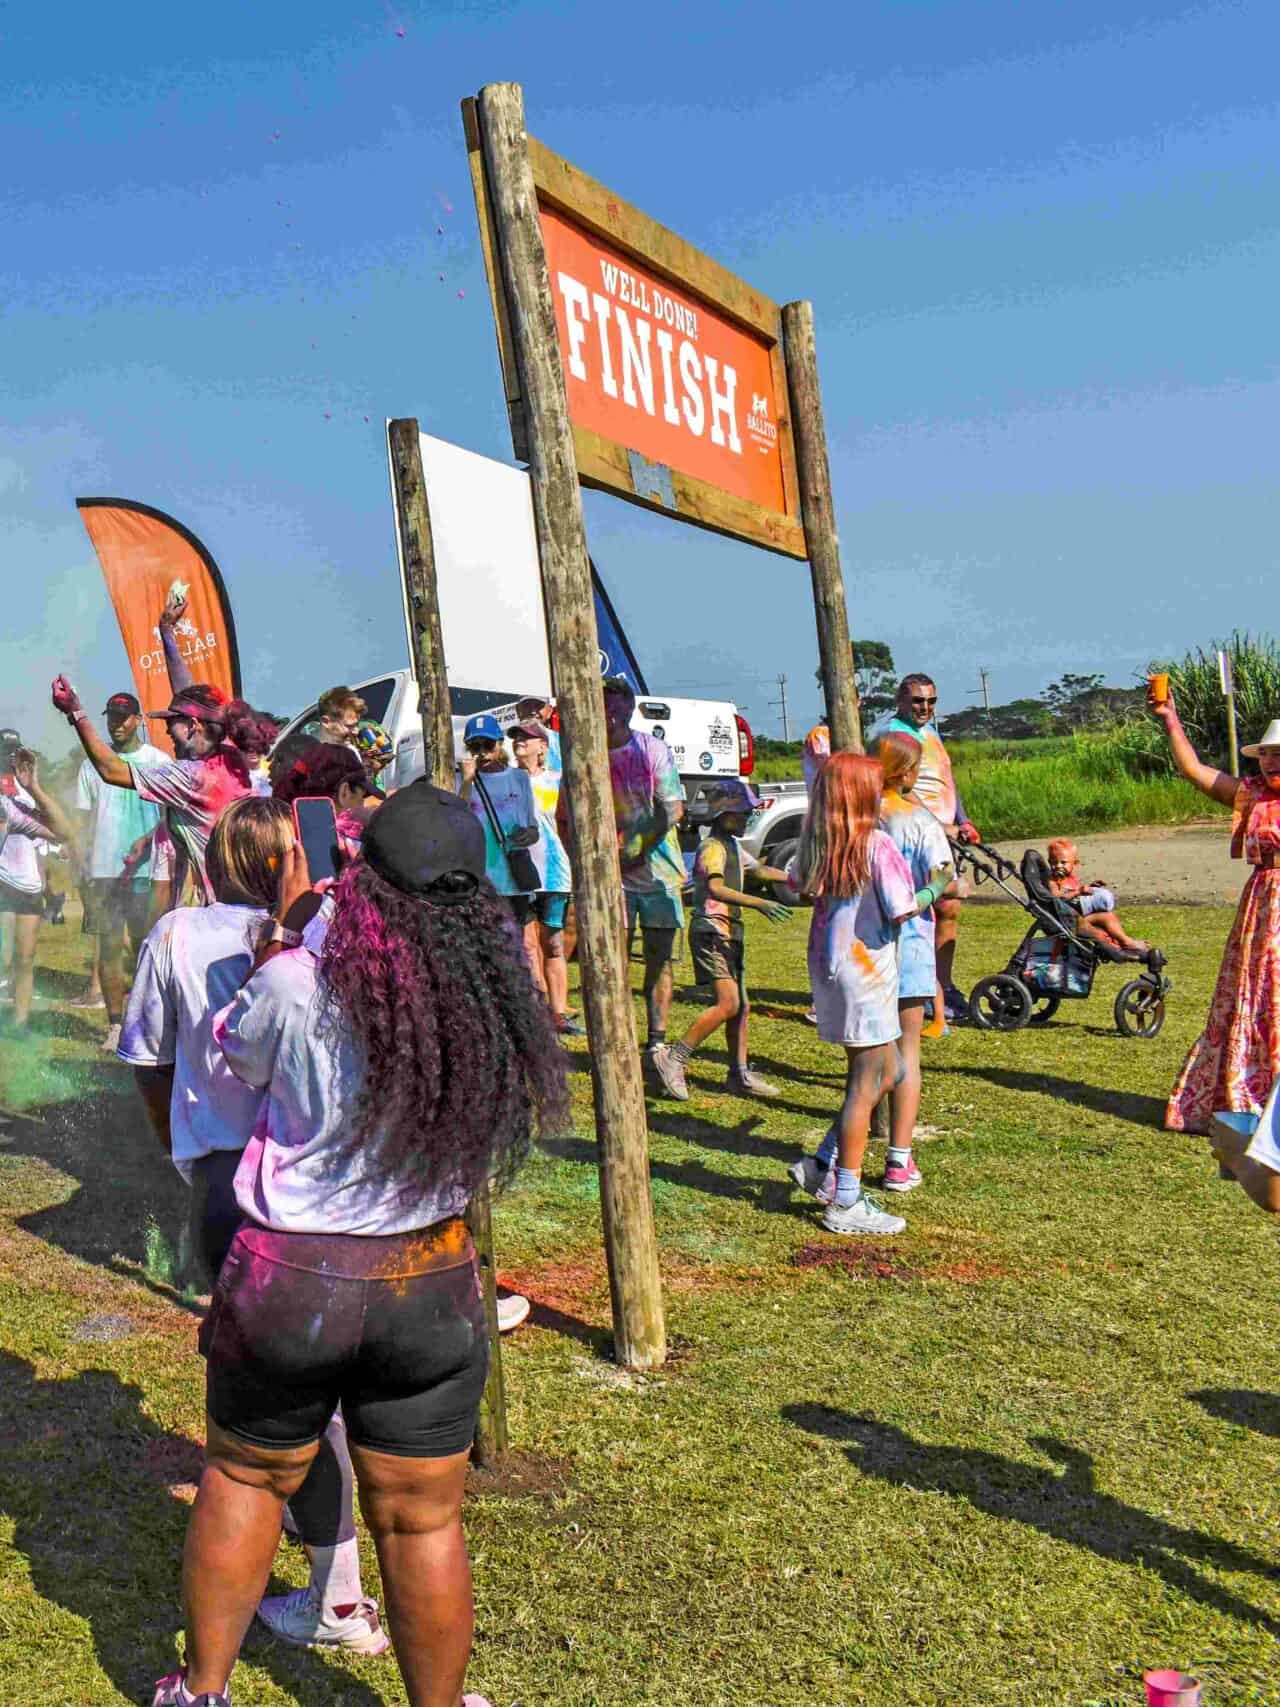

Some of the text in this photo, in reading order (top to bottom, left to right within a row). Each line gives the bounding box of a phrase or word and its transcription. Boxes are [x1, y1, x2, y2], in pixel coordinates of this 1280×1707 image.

[558, 271, 742, 454] FINISH
[600, 259, 699, 341] WELL DONE!
